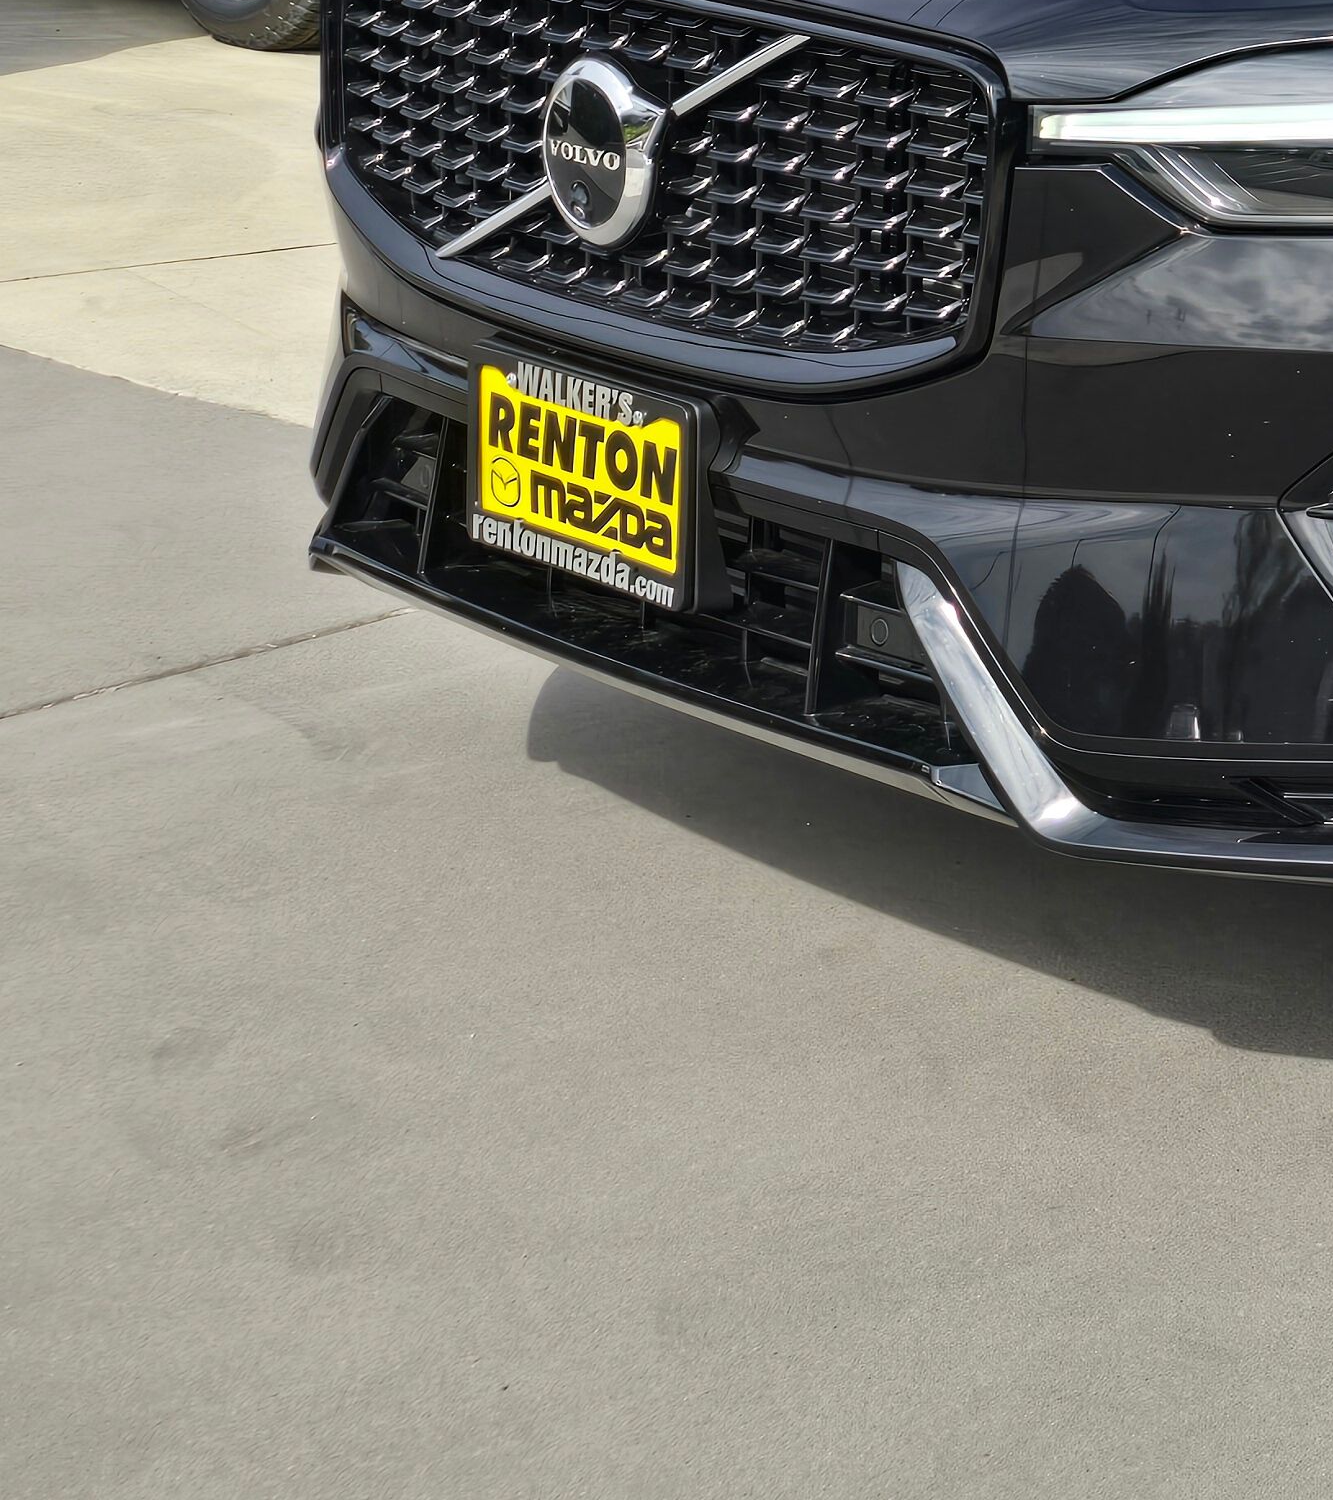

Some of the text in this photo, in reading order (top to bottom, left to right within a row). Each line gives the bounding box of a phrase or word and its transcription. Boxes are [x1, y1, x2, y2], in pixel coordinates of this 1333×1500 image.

[548, 136, 621, 171] VOLVO
[517, 361, 634, 426] WALKER'S
[488, 391, 678, 506] RENTON
[472, 513, 675, 609] rentonmazda.com
